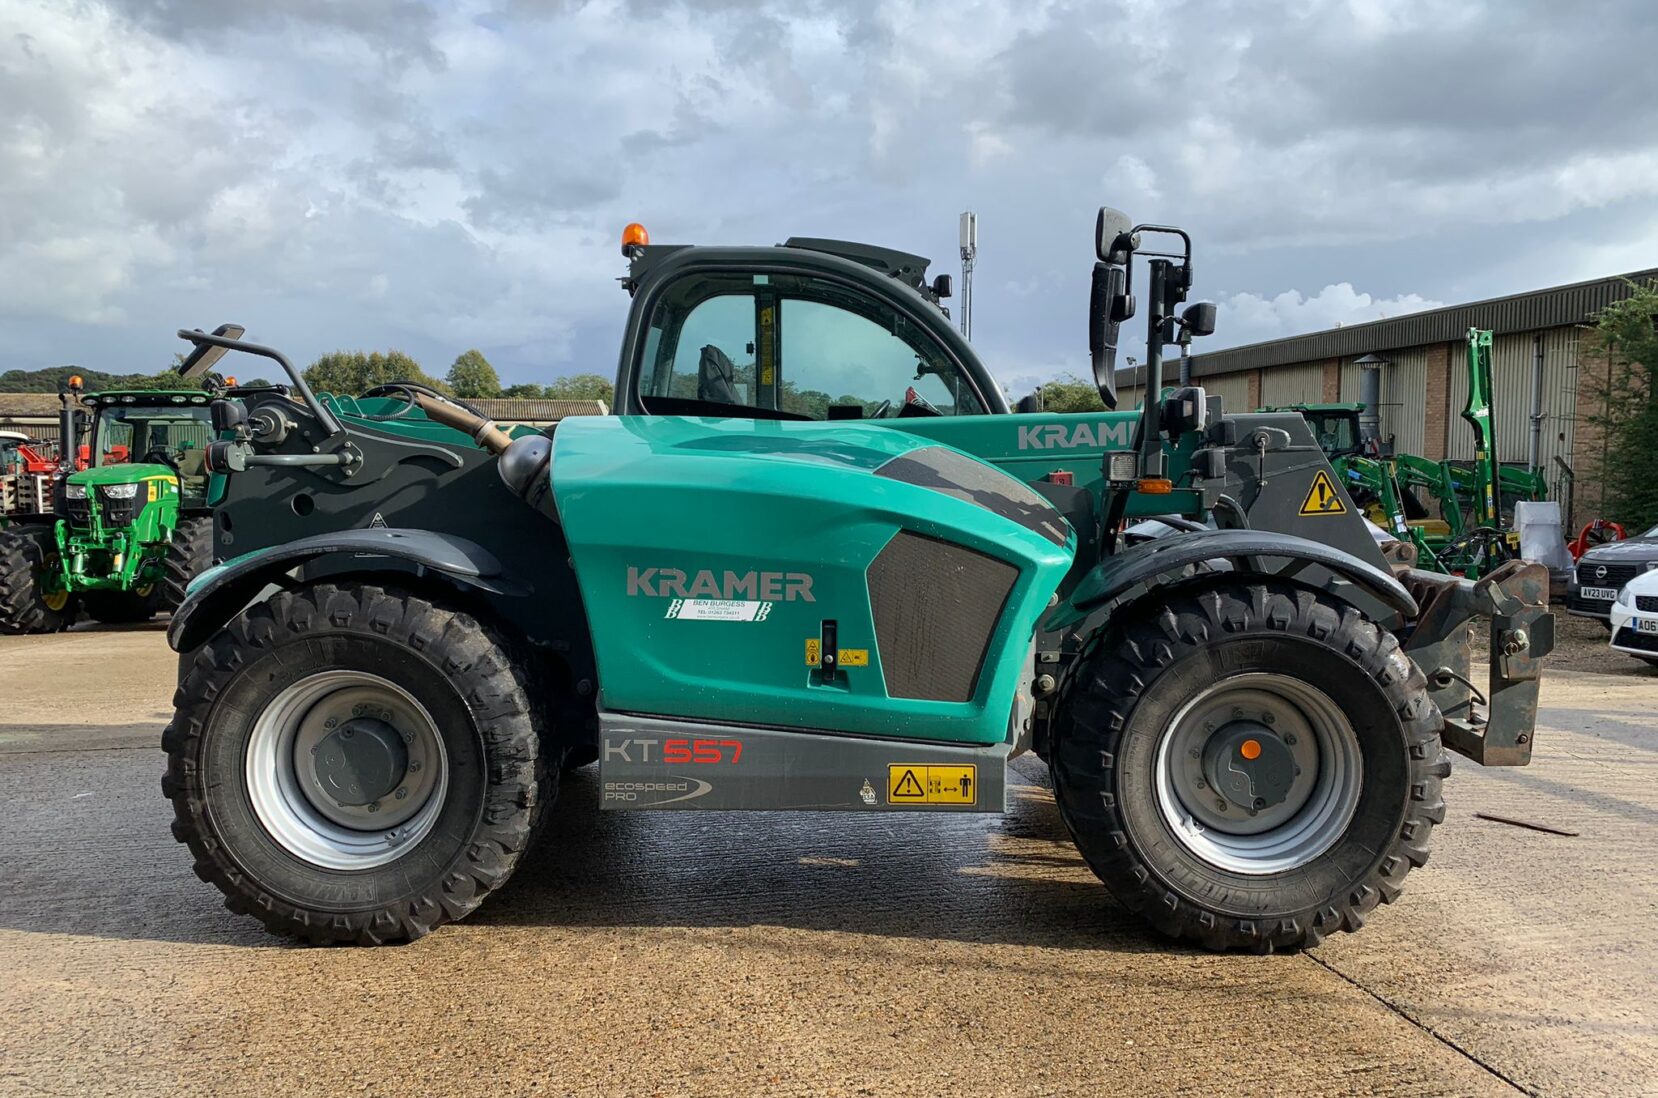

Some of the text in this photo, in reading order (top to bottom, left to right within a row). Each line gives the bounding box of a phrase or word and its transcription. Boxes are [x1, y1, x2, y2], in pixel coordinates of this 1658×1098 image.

[1018, 421, 1136, 450] KRAM
[626, 566, 817, 602] KRAMER
[1583, 588, 1615, 599] AV23 UVG
[710, 600, 746, 608] BURGESS
[1638, 619, 1658, 632] AO6
[604, 739, 659, 762] KT
[604, 782, 688, 793] ecospeed
[604, 792, 637, 801] PRO
